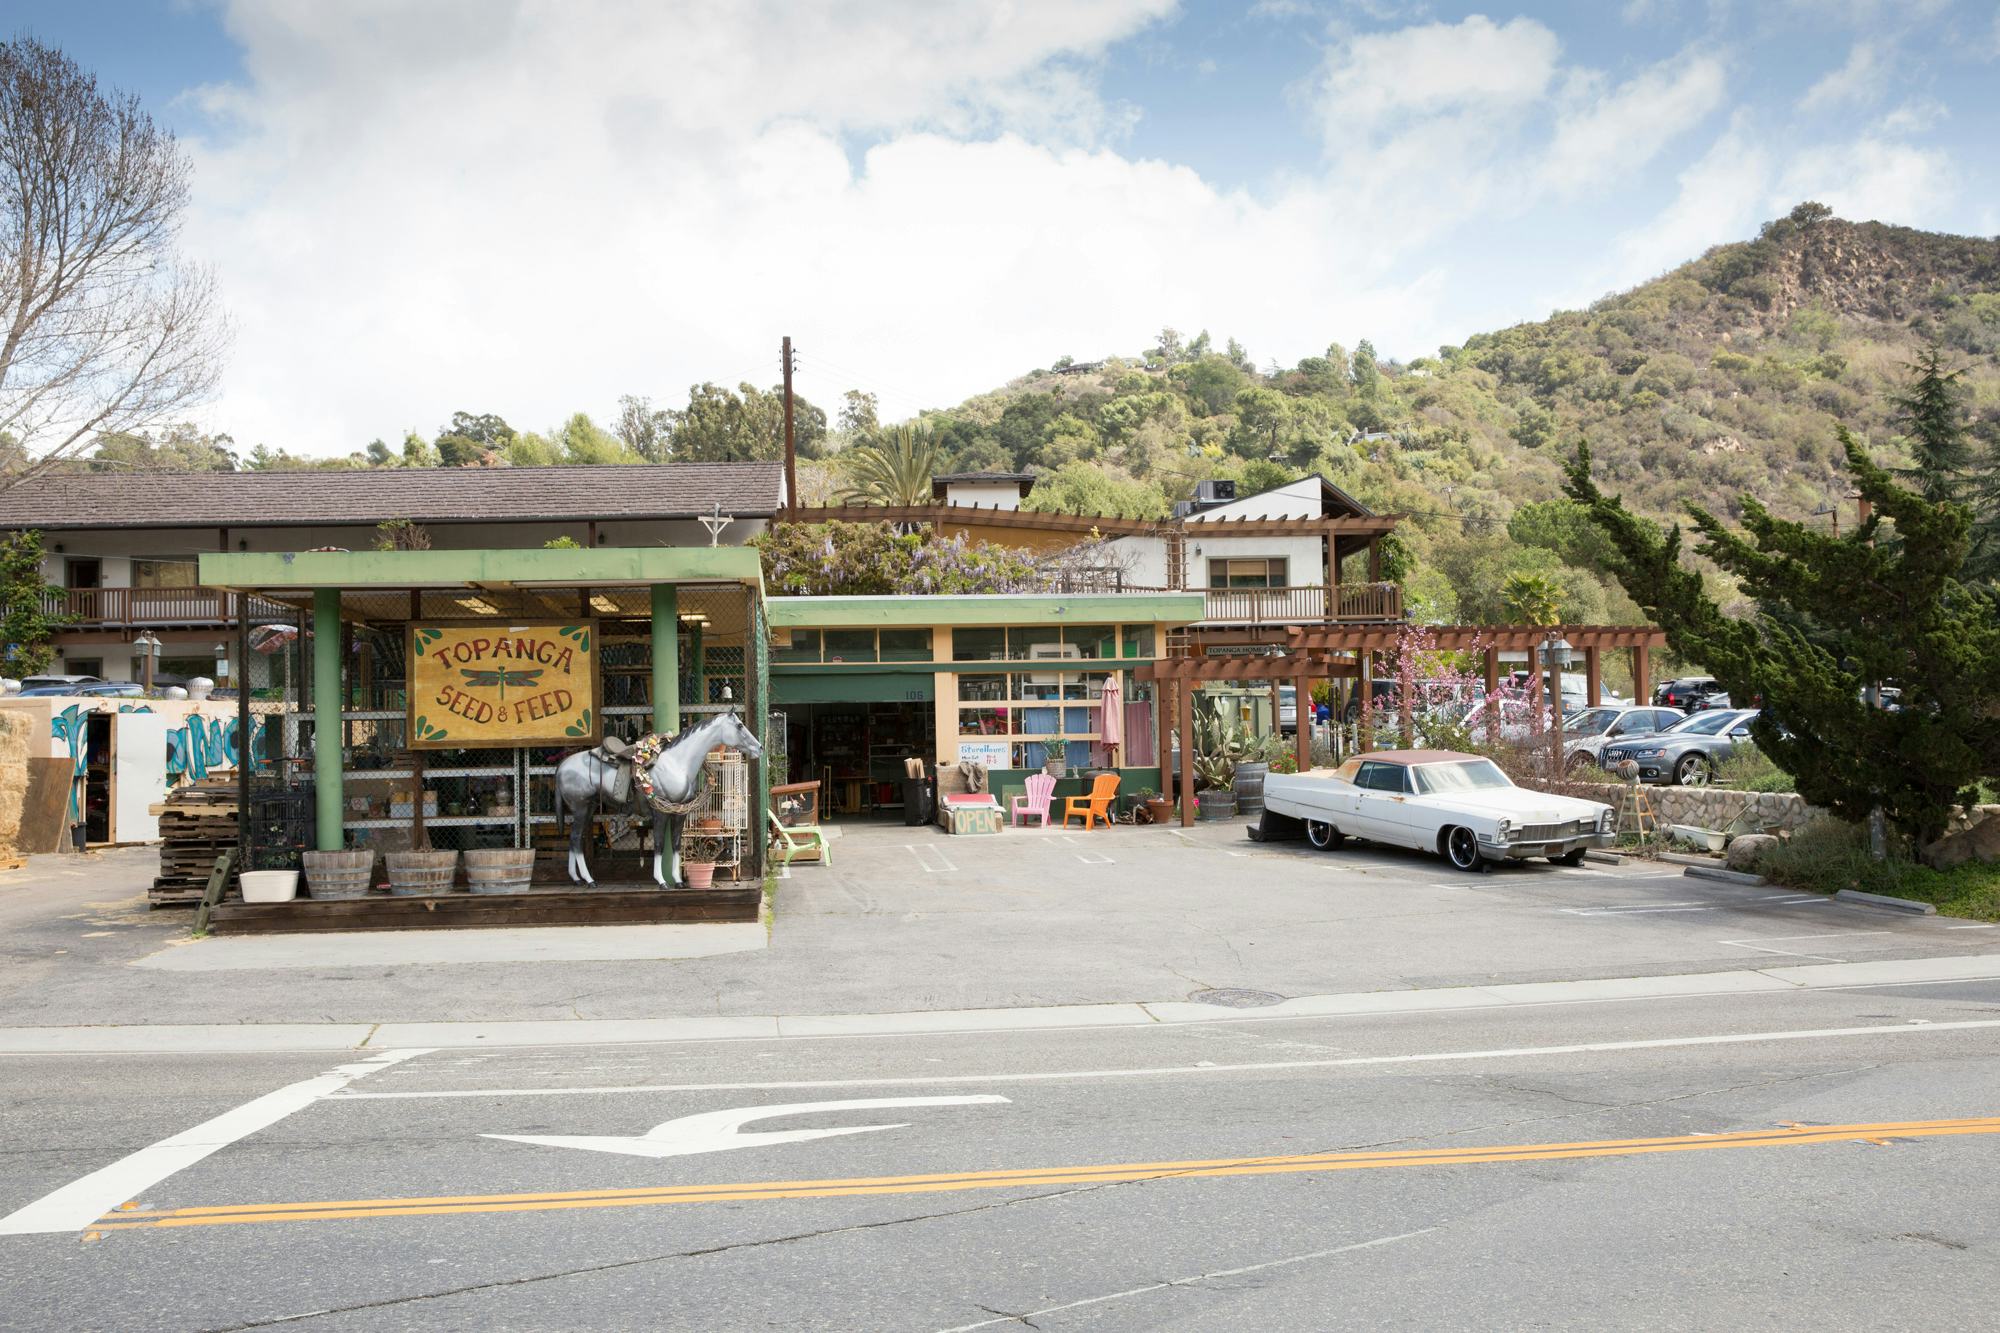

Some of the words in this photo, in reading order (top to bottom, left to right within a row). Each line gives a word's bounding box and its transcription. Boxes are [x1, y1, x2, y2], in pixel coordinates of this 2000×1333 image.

[432, 637, 574, 675] TOPANGA
[1208, 646, 1241, 654] TOPANGA
[436, 685, 493, 724] SEED
[498, 706, 508, 723] &
[513, 689, 573, 724] FEED
[905, 690, 924, 700] 106
[956, 810, 996, 832] OPEN
